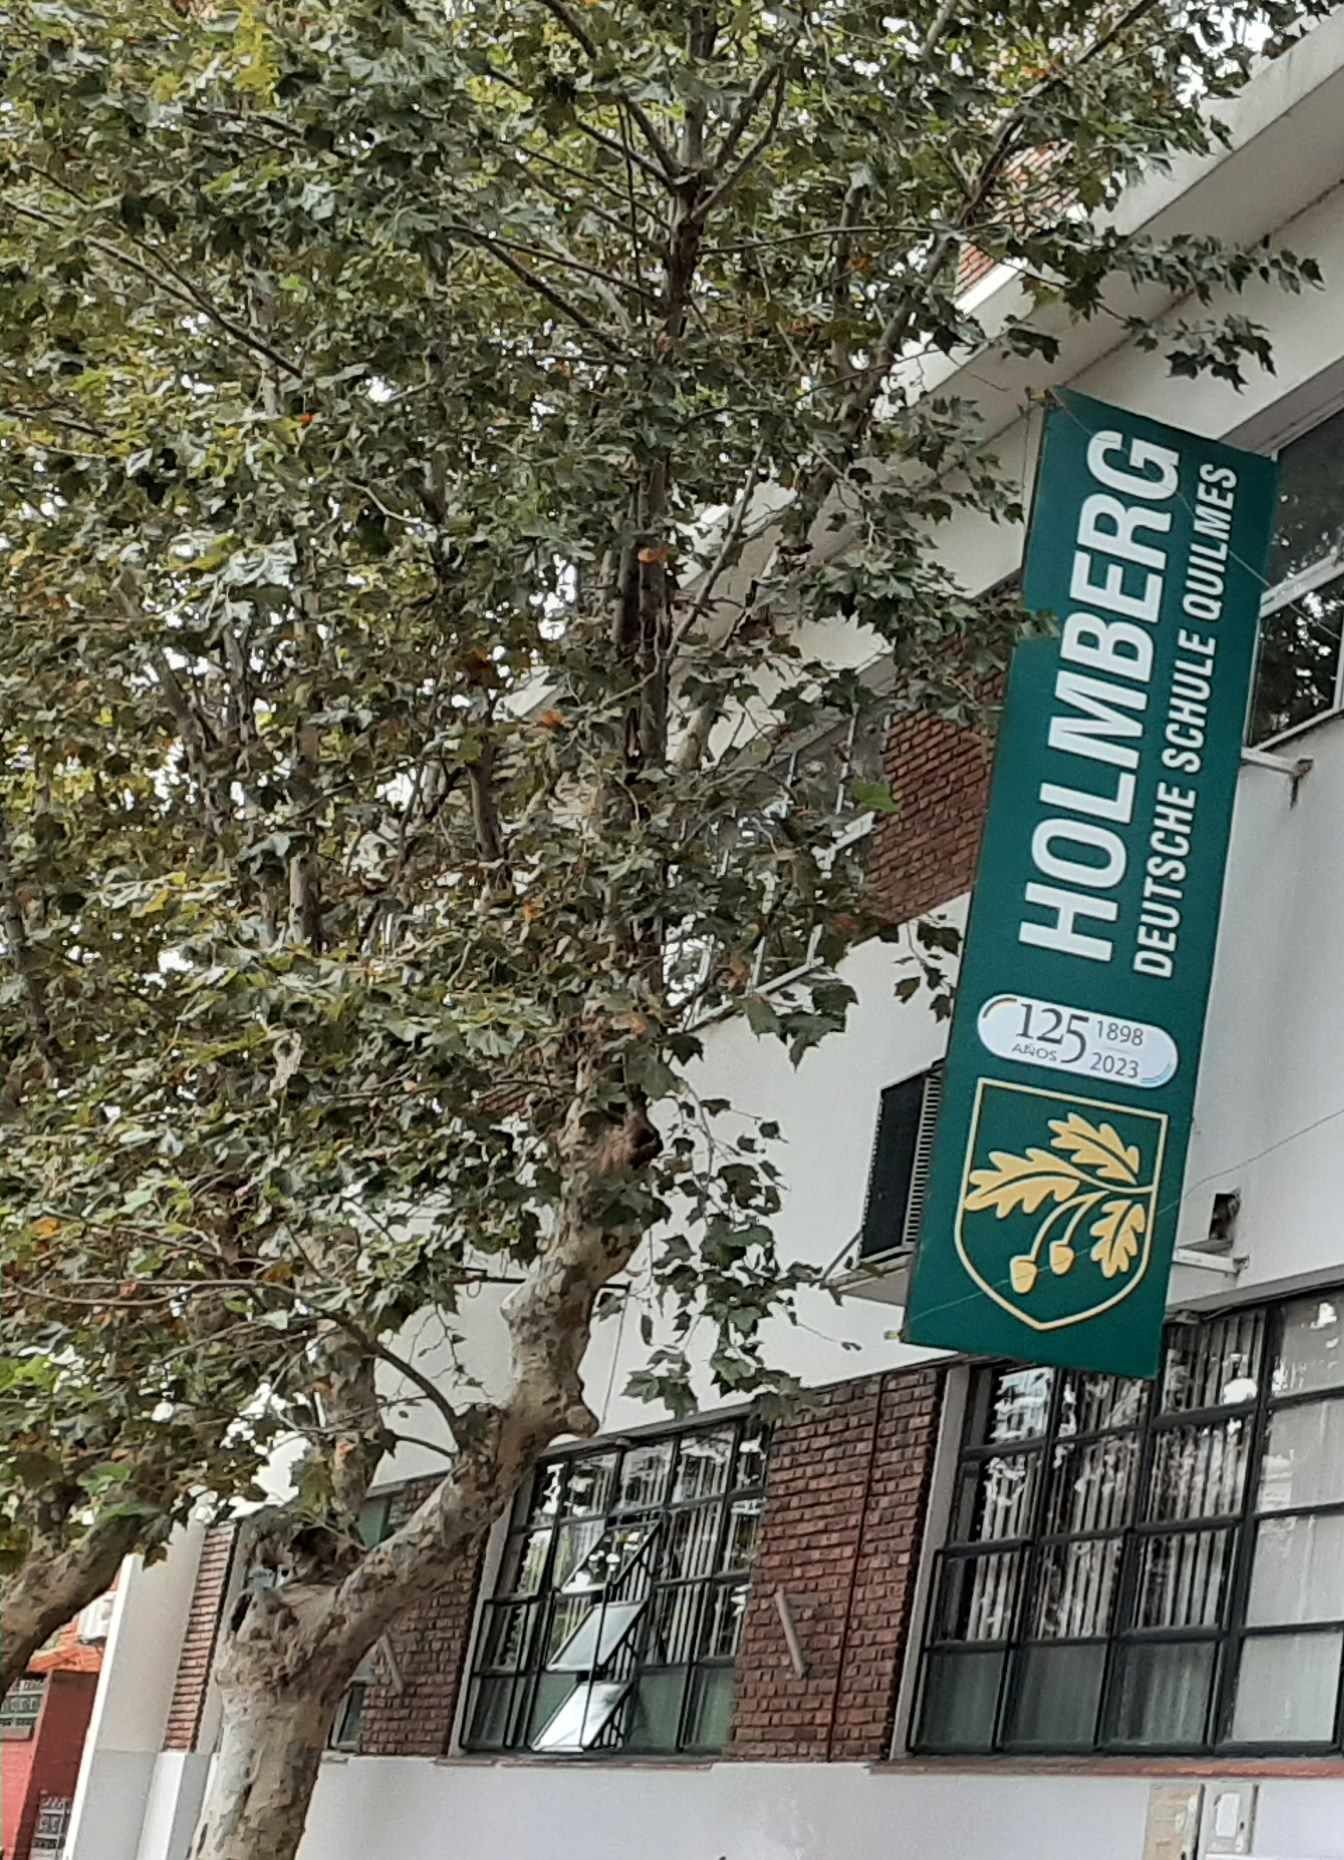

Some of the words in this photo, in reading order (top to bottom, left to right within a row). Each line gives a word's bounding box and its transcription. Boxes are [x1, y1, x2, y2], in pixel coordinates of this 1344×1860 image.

[1182, 463, 1238, 621] QUILMES
[1018, 430, 1180, 962] HOLMBERG
[1161, 629, 1216, 773] SCHULE
[1133, 782, 1197, 978] DEUTSCHE
[1015, 1003, 1090, 1064] 125
[1090, 1052, 1140, 1079] 2023
[1097, 1020, 1144, 1046] 1898
